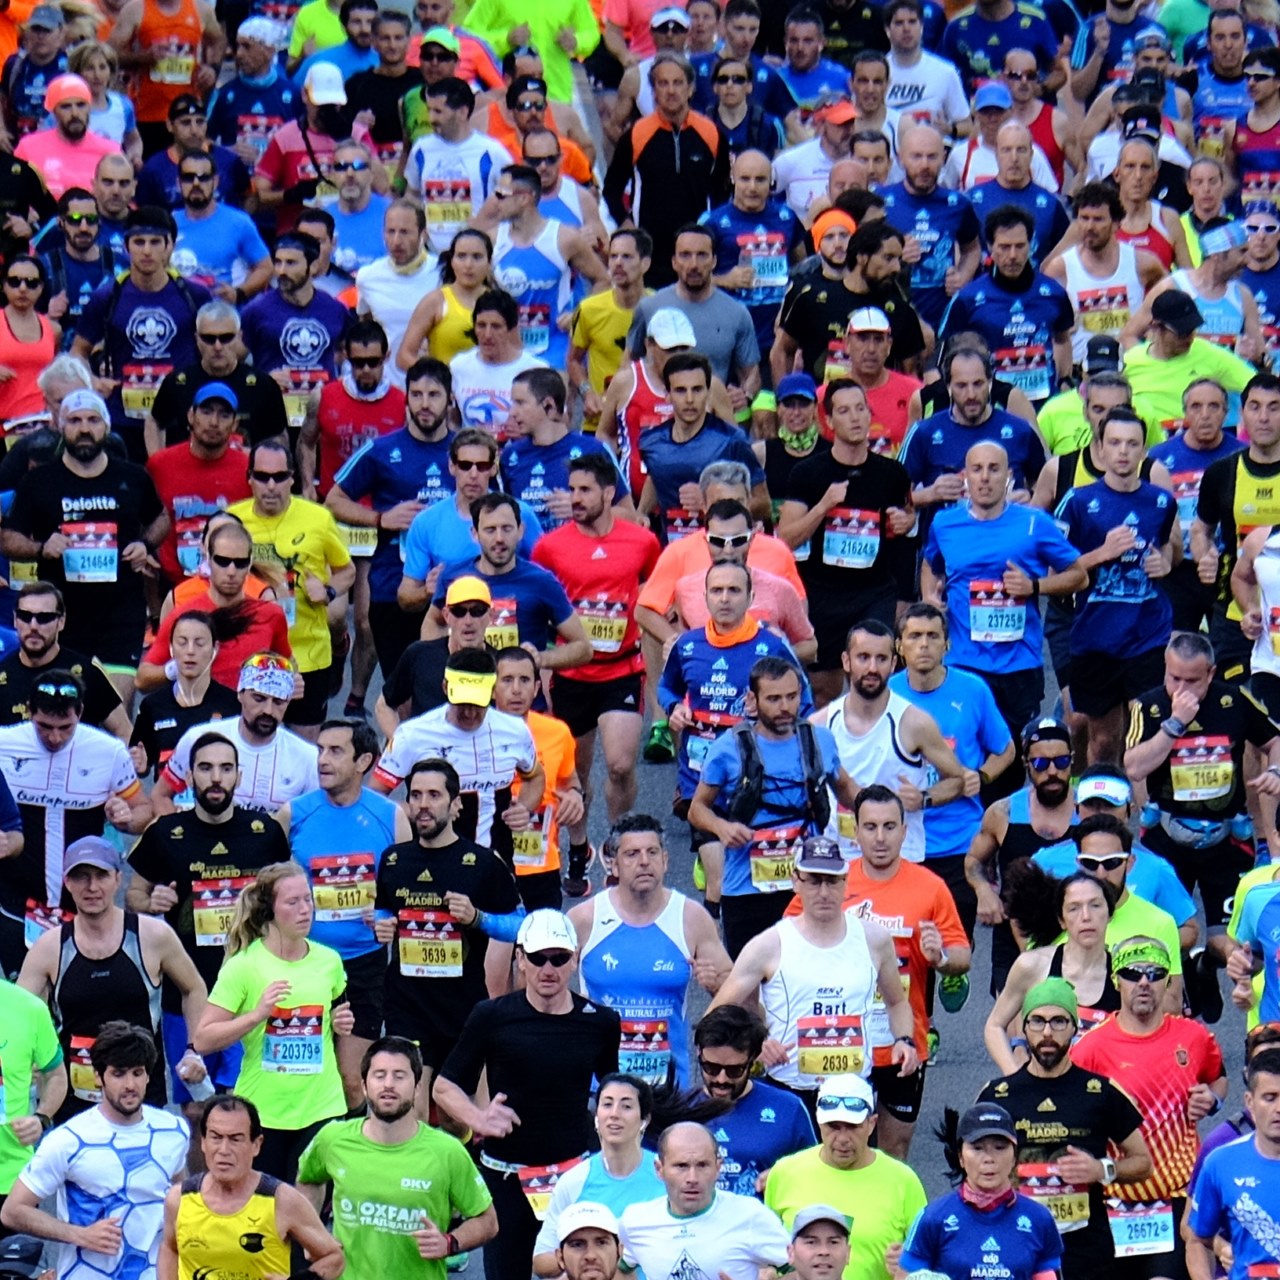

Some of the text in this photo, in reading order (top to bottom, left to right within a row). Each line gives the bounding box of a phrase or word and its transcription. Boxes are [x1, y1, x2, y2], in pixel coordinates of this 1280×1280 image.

[988, 610, 1017, 627] 23725
[699, 688, 737, 698] MADRID
[708, 701, 728, 711] 2017
[201, 869, 241, 880] MADRID
[336, 888, 362, 905] 6117
[404, 896, 443, 907] MADRID
[421, 946, 447, 964] 3639
[812, 1001, 848, 1017] Bart
[281, 1043, 314, 1061] 20379
[822, 1053, 849, 1073] 2639
[1025, 1125, 1069, 1140] MADRID
[400, 1176, 432, 1191] DKV
[359, 1202, 427, 1220] OXFAM
[970, 1266, 1012, 1279] MADRID
